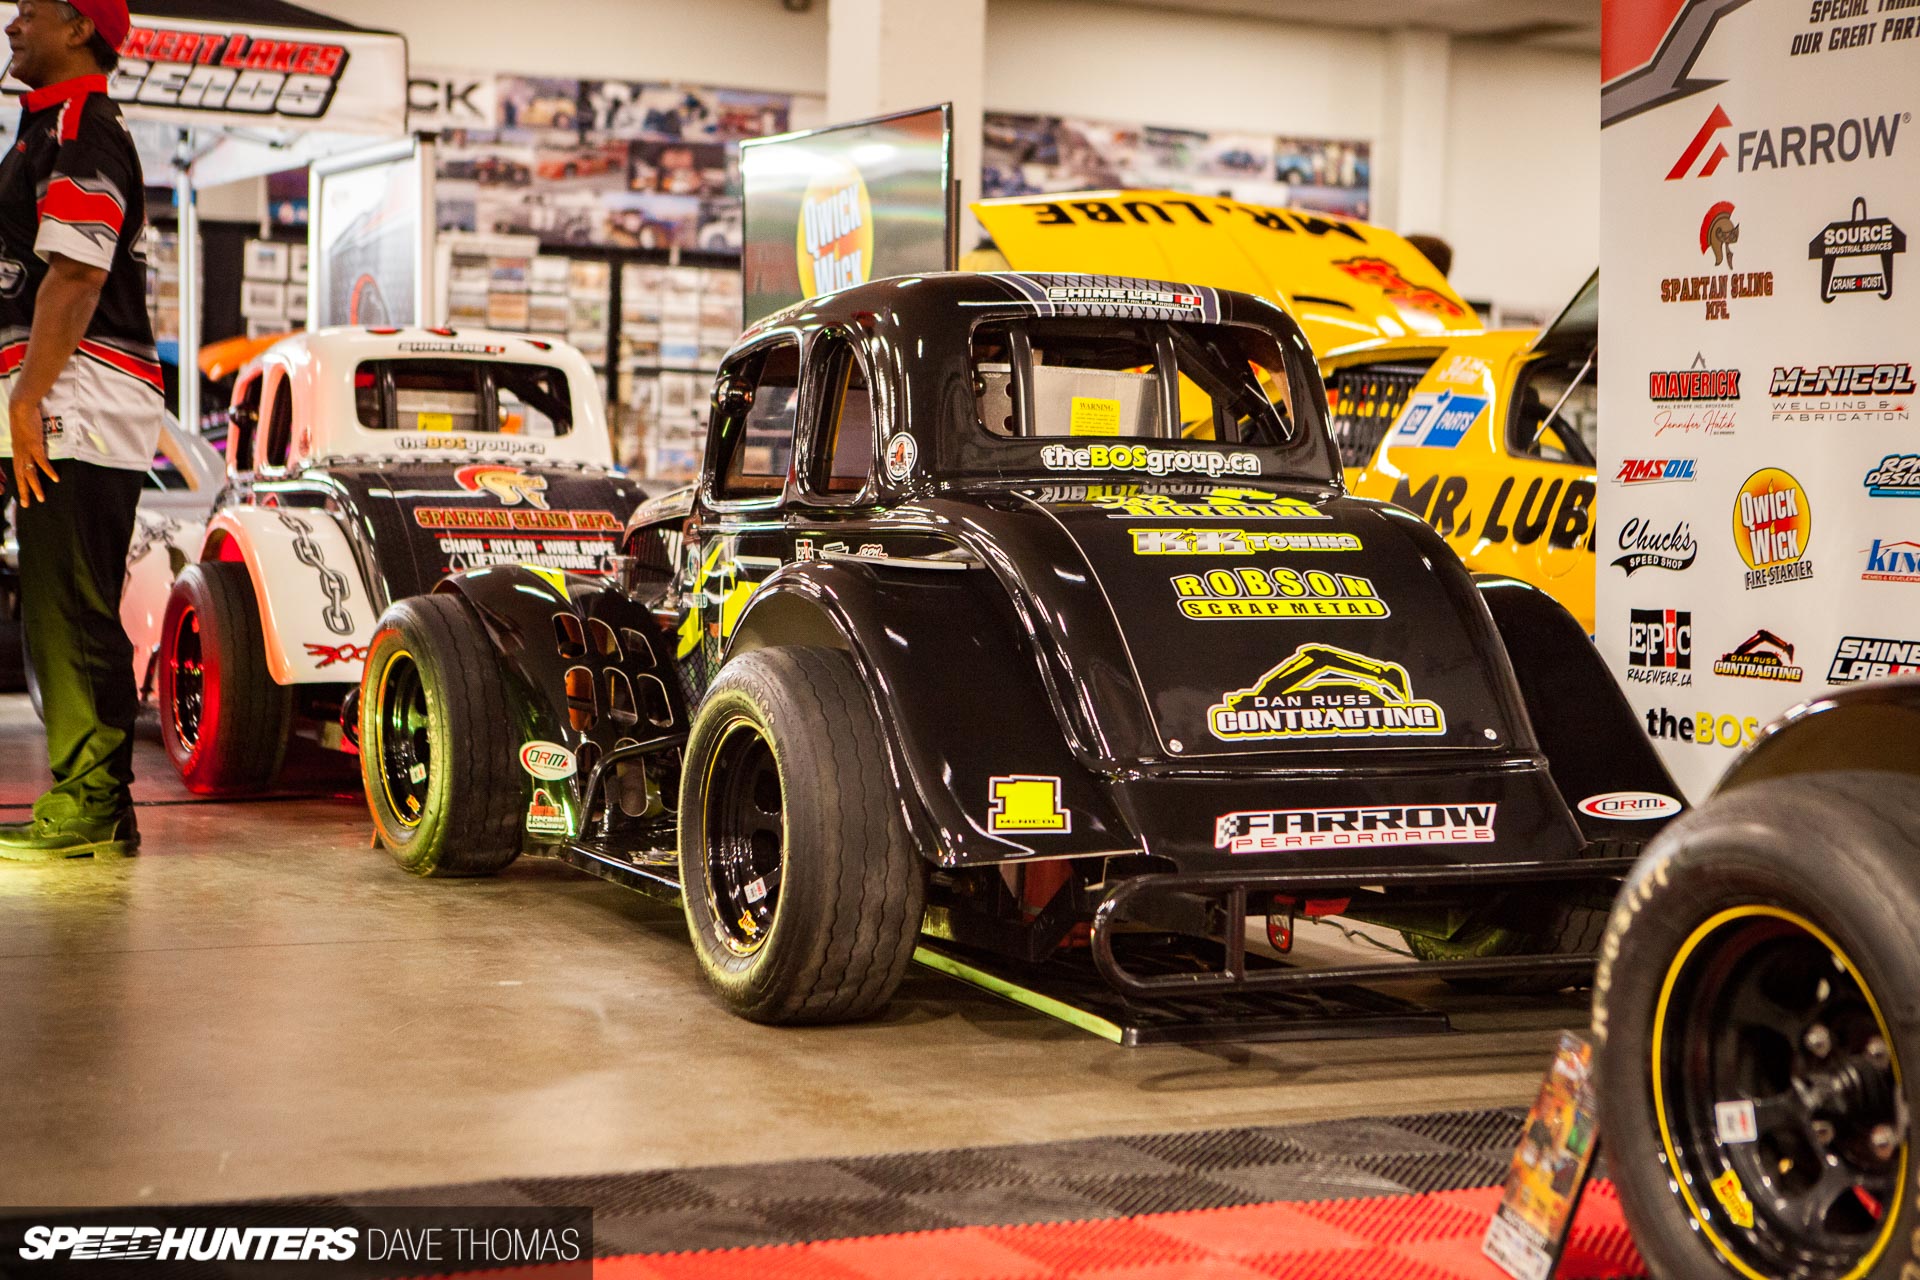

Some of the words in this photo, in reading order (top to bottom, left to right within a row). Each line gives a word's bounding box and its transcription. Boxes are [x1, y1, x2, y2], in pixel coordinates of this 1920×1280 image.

[1809, 0, 1868, 23] SPECIAL
[1790, 32, 1823, 56] OUR
[1828, 22, 1877, 51] GREAT
[120, 27, 225, 65] REAT
[221, 34, 347, 77] LAKES
[1030, 199, 1214, 226] LUBE
[1824, 223, 1893, 246] SOURCE
[1824, 245, 1862, 256] INDUSTRIAL
[1862, 242, 1893, 253] SERVICES
[1661, 275, 1729, 302] SPARTAN
[1731, 271, 1774, 299] SLING
[1832, 277, 1857, 291] CRANE
[1861, 275, 1883, 288] HOIST
[1650, 370, 1740, 400] MAVERICK
[1772, 401, 1867, 411] WELDING
[1879, 400, 1890, 410] &
[1435, 410, 1475, 432] PARTS
[1772, 412, 1910, 422] FABRICATION
[394, 436, 546, 455] theBOSgroup.ca
[1042, 446, 1260, 476] theBOSgroup.ca
[1616, 458, 1696, 481] AMSOIL
[416, 509, 510, 529] SPARTAN
[511, 510, 572, 530] SLING
[1120, 506, 1327, 519] RECYCLING
[1249, 535, 1359, 551] TOWING
[1618, 517, 1691, 552] Chuck's
[439, 539, 484, 555] CHAIN
[489, 539, 538, 555] NYLON
[541, 540, 578, 556] WIRE
[580, 541, 617, 556] ROPE
[517, 554, 597, 570] HARDWARE
[1629, 554, 1659, 568] SPEED
[1661, 557, 1683, 570] SHOP
[1174, 568, 1372, 598] ROBSON
[1189, 602, 1280, 616] SCRAP
[1292, 602, 1378, 616] METAL
[1629, 621, 1691, 656] EPIC
[1730, 654, 1751, 663] DAN
[1753, 656, 1778, 665] RUSS
[1829, 659, 1891, 681] LAB
[1714, 660, 1802, 681] CONTRACTING
[1254, 695, 1302, 708] DAN
[1311, 694, 1371, 707] RUSS
[1215, 705, 1436, 732] CONTRACTING
[1236, 805, 1492, 836] FARROW
[1236, 829, 1491, 850] PERFORMANCE
